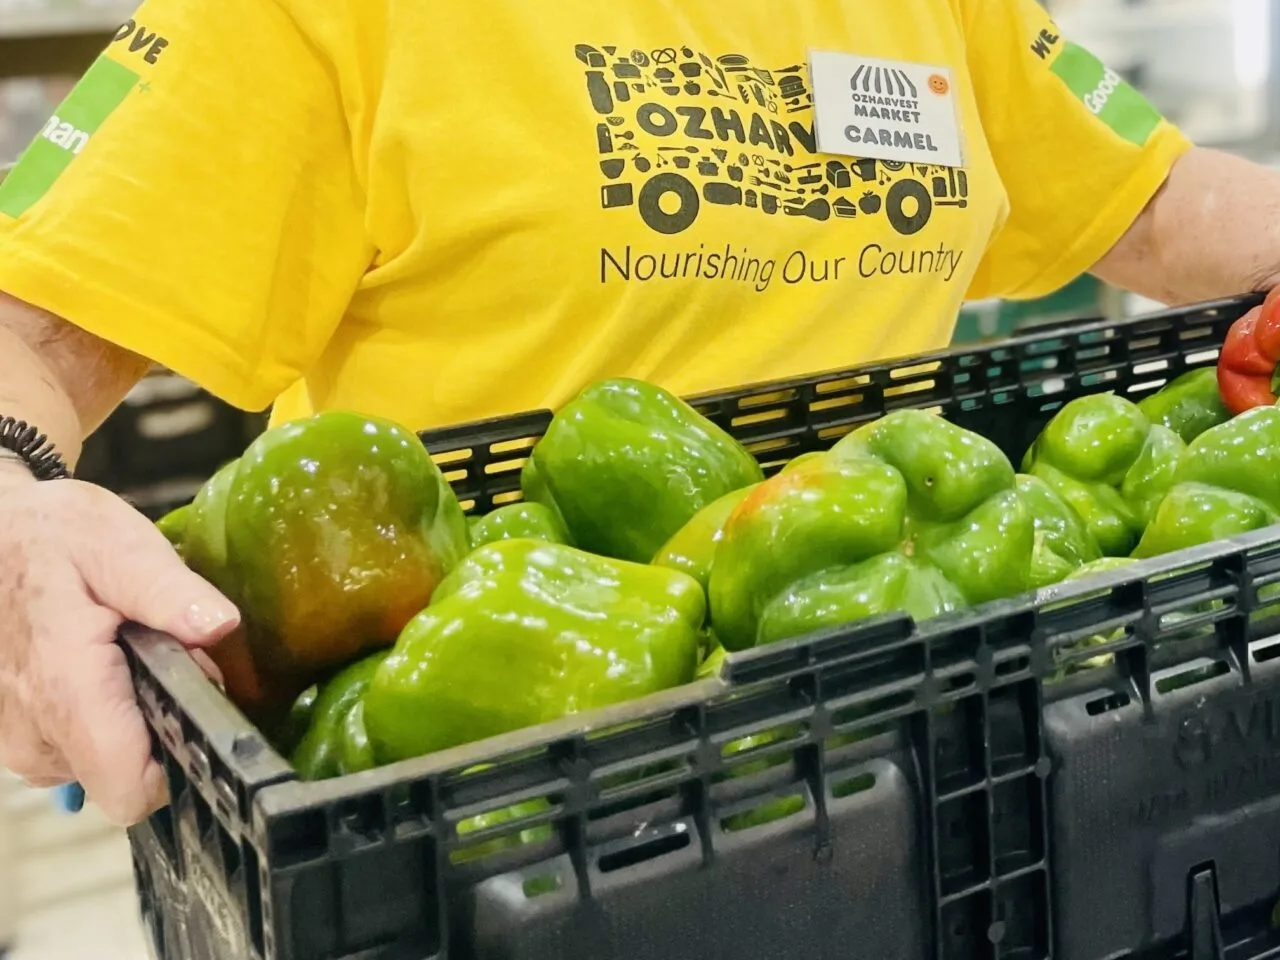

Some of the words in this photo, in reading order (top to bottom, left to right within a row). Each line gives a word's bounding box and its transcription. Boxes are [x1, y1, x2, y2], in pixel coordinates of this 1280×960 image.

[1030, 28, 1060, 60] WE
[851, 94, 919, 110] OZHARVEST
[1083, 67, 1121, 114] Good
[854, 104, 921, 123] MARKET
[844, 125, 938, 152] CARMEL
[600, 244, 776, 291] Nourishing
[782, 250, 846, 283] Our
[858, 242, 963, 281] Country
